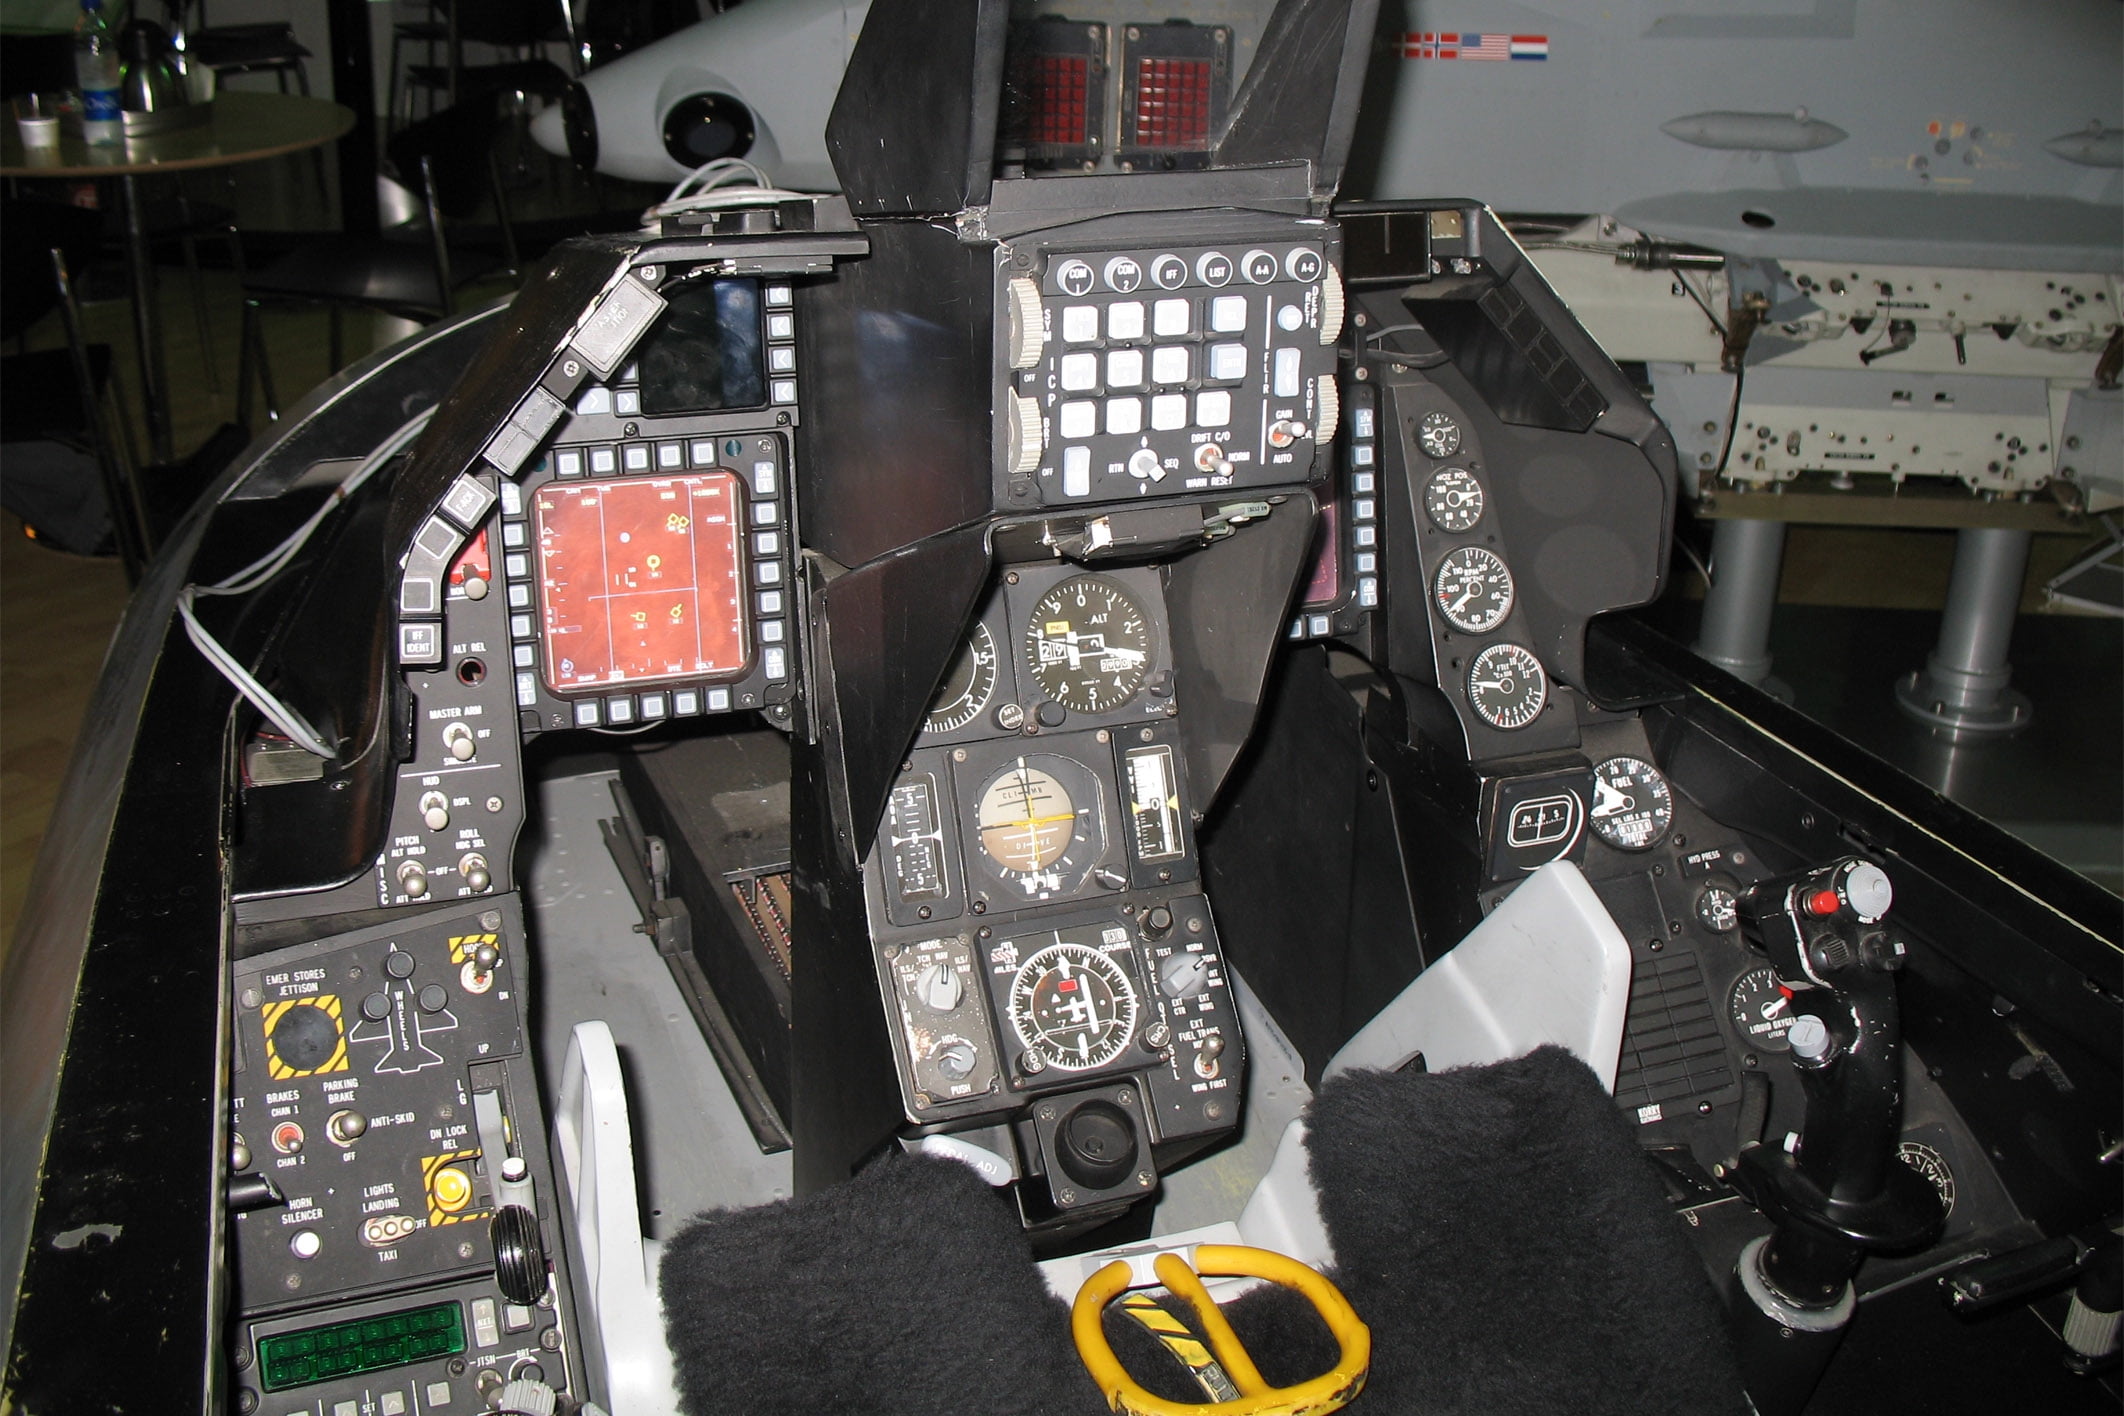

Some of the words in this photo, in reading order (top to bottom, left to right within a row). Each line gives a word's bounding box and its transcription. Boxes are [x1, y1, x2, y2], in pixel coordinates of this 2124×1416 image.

[1068, 268, 1087, 279] COM
[1117, 264, 1136, 276] COM
[1209, 266, 1226, 278] LIST
[1255, 265, 1270, 276] A-A
[1301, 262, 1315, 273] A-G
[1166, 269, 1178, 280] IFF
[1124, 280, 1130, 290] 2
[1024, 374, 1036, 384] OFF
[1276, 409, 1294, 420] GAIN
[1191, 432, 1214, 443] DRIFT
[1215, 430, 1231, 442] C/O
[1228, 451, 1250, 463] NORM
[1273, 452, 1293, 464] AUTO
[1108, 464, 1124, 474] RTN
[1164, 458, 1180, 470] SEQ
[1042, 468, 1054, 478] OFF
[1454, 472, 1468, 480] POS
[1186, 478, 1208, 489] WARN
[1211, 474, 1233, 487] RESET
[1452, 567, 1464, 576] 110
[1464, 568, 1480, 576] RPM
[1478, 564, 1488, 572] 20
[1459, 574, 1485, 584] PERCENT
[1446, 584, 1460, 593] 100
[1077, 594, 1086, 607] 0
[1491, 592, 1500, 600] 60
[1052, 602, 1062, 614] 9
[1486, 610, 1496, 618] 70
[1090, 612, 1108, 625] ALT
[1471, 614, 1481, 622] 80
[1124, 621, 1132, 634] 2
[412, 631, 424, 640] IFF
[1036, 629, 1044, 640] 8
[406, 642, 432, 653] IDENT
[453, 644, 467, 654] ALT
[471, 642, 486, 652] REL
[1509, 656, 1518, 666] 10
[1518, 662, 1525, 671] 11
[1522, 670, 1531, 678] 12
[1060, 681, 1070, 694] 6
[1088, 688, 1098, 700] 5
[965, 694, 974, 708] 2
[429, 707, 462, 720] MASTER
[464, 706, 482, 716] ARM
[478, 729, 491, 739] OFF
[1608, 766, 1620, 775] 20
[422, 776, 440, 786] HUD
[1612, 776, 1634, 788] FUEL
[453, 797, 472, 807] DSPL
[906, 792, 914, 805] 5
[1150, 798, 1160, 811] 0
[1655, 808, 1665, 817] 40
[460, 828, 480, 840] ROLL
[395, 835, 420, 847] PITCH
[455, 840, 470, 850] HDG
[472, 838, 486, 848] SEL
[391, 848, 404, 858] ALT
[406, 846, 426, 856] HOLD
[1688, 854, 1701, 864] HYD
[1701, 850, 1722, 862] PRESS
[435, 866, 448, 876] OFF
[1704, 862, 1710, 870] A
[916, 872, 924, 886] 5
[458, 886, 471, 897] ATT
[396, 894, 409, 904] ATT
[920, 940, 941, 951] MODE
[1099, 940, 1132, 952] COURSE
[1186, 942, 1204, 952] NORM
[1156, 947, 1172, 958] TEST
[958, 964, 971, 973] NAV
[266, 974, 292, 986] EMER
[294, 968, 326, 982] STORES
[1208, 978, 1224, 987] WING
[278, 982, 319, 997] JETTISON
[1752, 983, 1758, 993] 2
[1767, 979, 1773, 988] 3
[1172, 998, 1184, 1007] EXT
[1198, 993, 1210, 1002] EXT
[1174, 1007, 1187, 1016] CTR
[1198, 1002, 1215, 1012] WING
[394, 990, 410, 1052] WHEELS
[1190, 1018, 1204, 1029] EXT
[1749, 1021, 1772, 1034] LIQUID
[942, 1034, 959, 1045] HDG
[1150, 1024, 1166, 1044] CRS
[1178, 1032, 1196, 1042] FUEL
[1196, 1026, 1221, 1038] TRANS
[1768, 1030, 1786, 1039] LITERS
[478, 1044, 490, 1055] UP
[1027, 1049, 1042, 1071] HDG
[323, 1078, 360, 1092] PARKING
[951, 1084, 972, 1096] PUSH
[1192, 1082, 1208, 1092] WING
[1210, 1078, 1228, 1090] FIRST
[266, 1090, 300, 1104] BRAKES
[328, 1090, 356, 1104] BRAKE
[271, 1106, 292, 1118] CHAN
[370, 1112, 416, 1128] ANTI-SKID
[430, 1128, 446, 1140] DN
[448, 1124, 468, 1138] LOCK
[442, 1138, 459, 1151] REL
[277, 1156, 298, 1168] CHAN
[300, 1154, 306, 1165] 2
[342, 1151, 356, 1163] OFF
[976, 1160, 998, 1175] ADJ
[1926, 1164, 1935, 1174] 2
[1936, 1177, 1944, 1188] 3
[364, 1183, 395, 1198] LIGHTS
[289, 1198, 313, 1210] HORN
[362, 1198, 400, 1214] LANDING
[282, 1208, 324, 1224] SILENCER
[378, 1250, 398, 1262] TAXI
[516, 1348, 530, 1358] BRT
[478, 1354, 496, 1368] JTSN
[362, 1402, 376, 1414] SET
